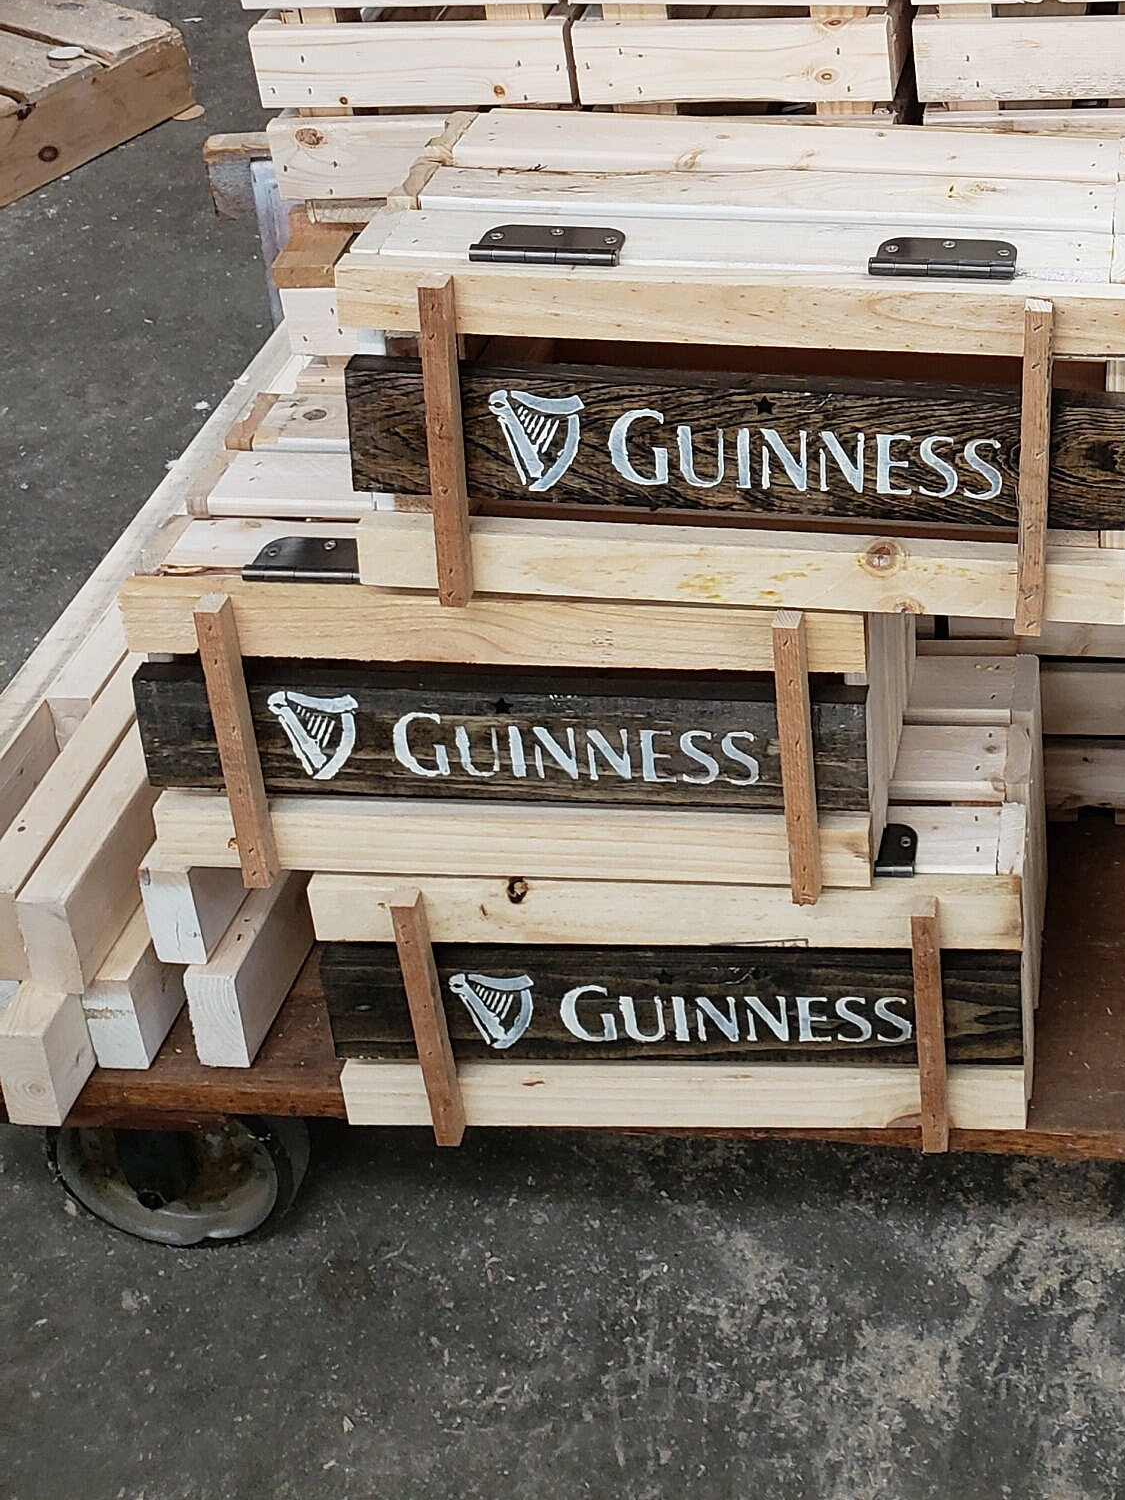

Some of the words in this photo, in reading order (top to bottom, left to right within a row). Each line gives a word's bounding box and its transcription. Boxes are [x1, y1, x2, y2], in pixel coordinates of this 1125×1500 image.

[610, 410, 1002, 499] GUINNESS
[394, 713, 760, 784] GUINNESS
[560, 986, 914, 1042] GUINNESS
